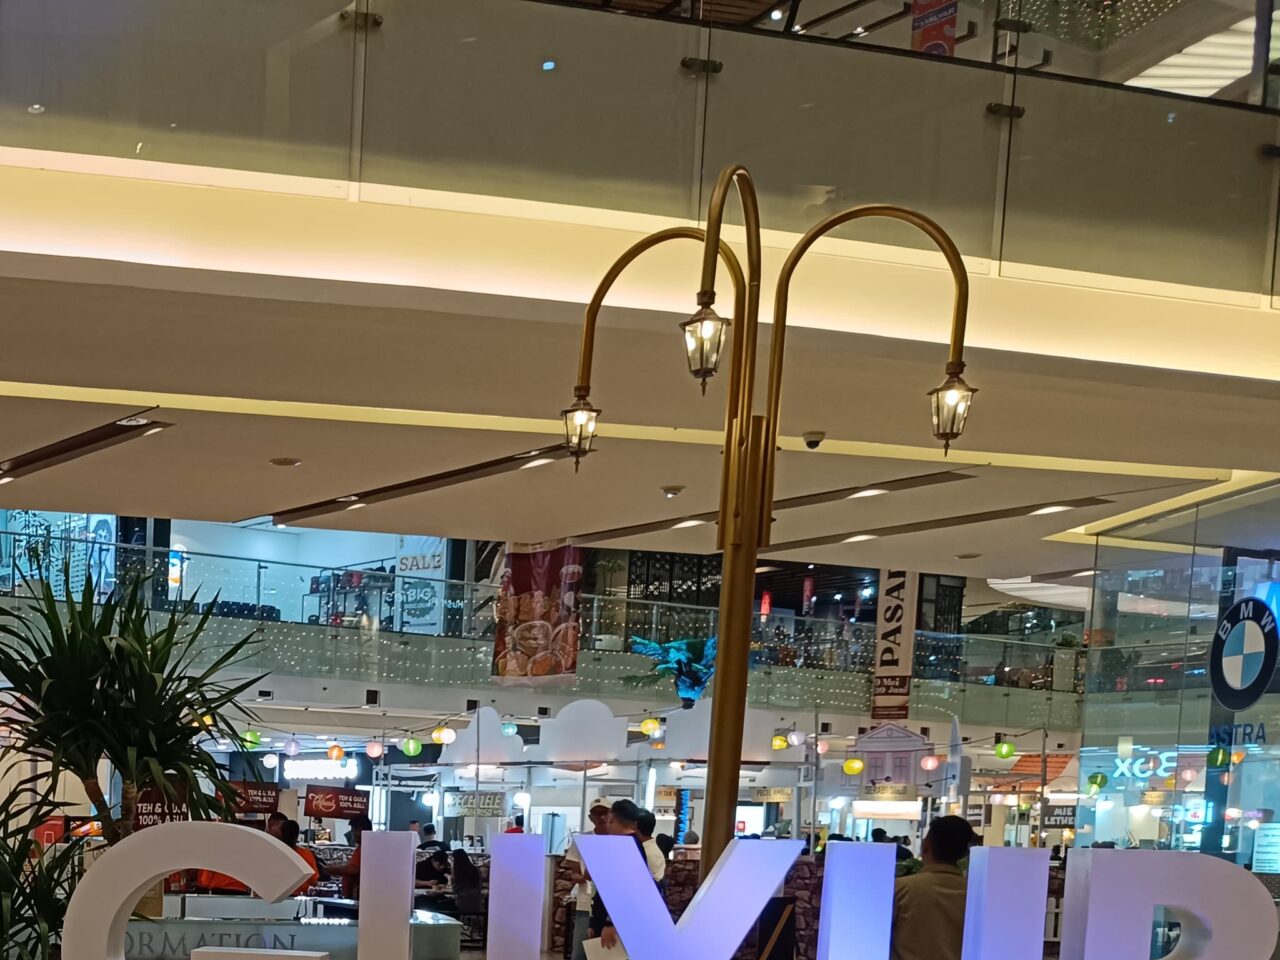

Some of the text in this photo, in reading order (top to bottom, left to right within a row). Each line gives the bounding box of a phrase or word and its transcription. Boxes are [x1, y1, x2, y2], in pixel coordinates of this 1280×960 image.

[399, 553, 442, 571] SALE
[1218, 601, 1275, 640] BMW
[1208, 722, 1266, 747] ASTRA
[136, 802, 153, 813] TEH
[154, 802, 162, 813] &
